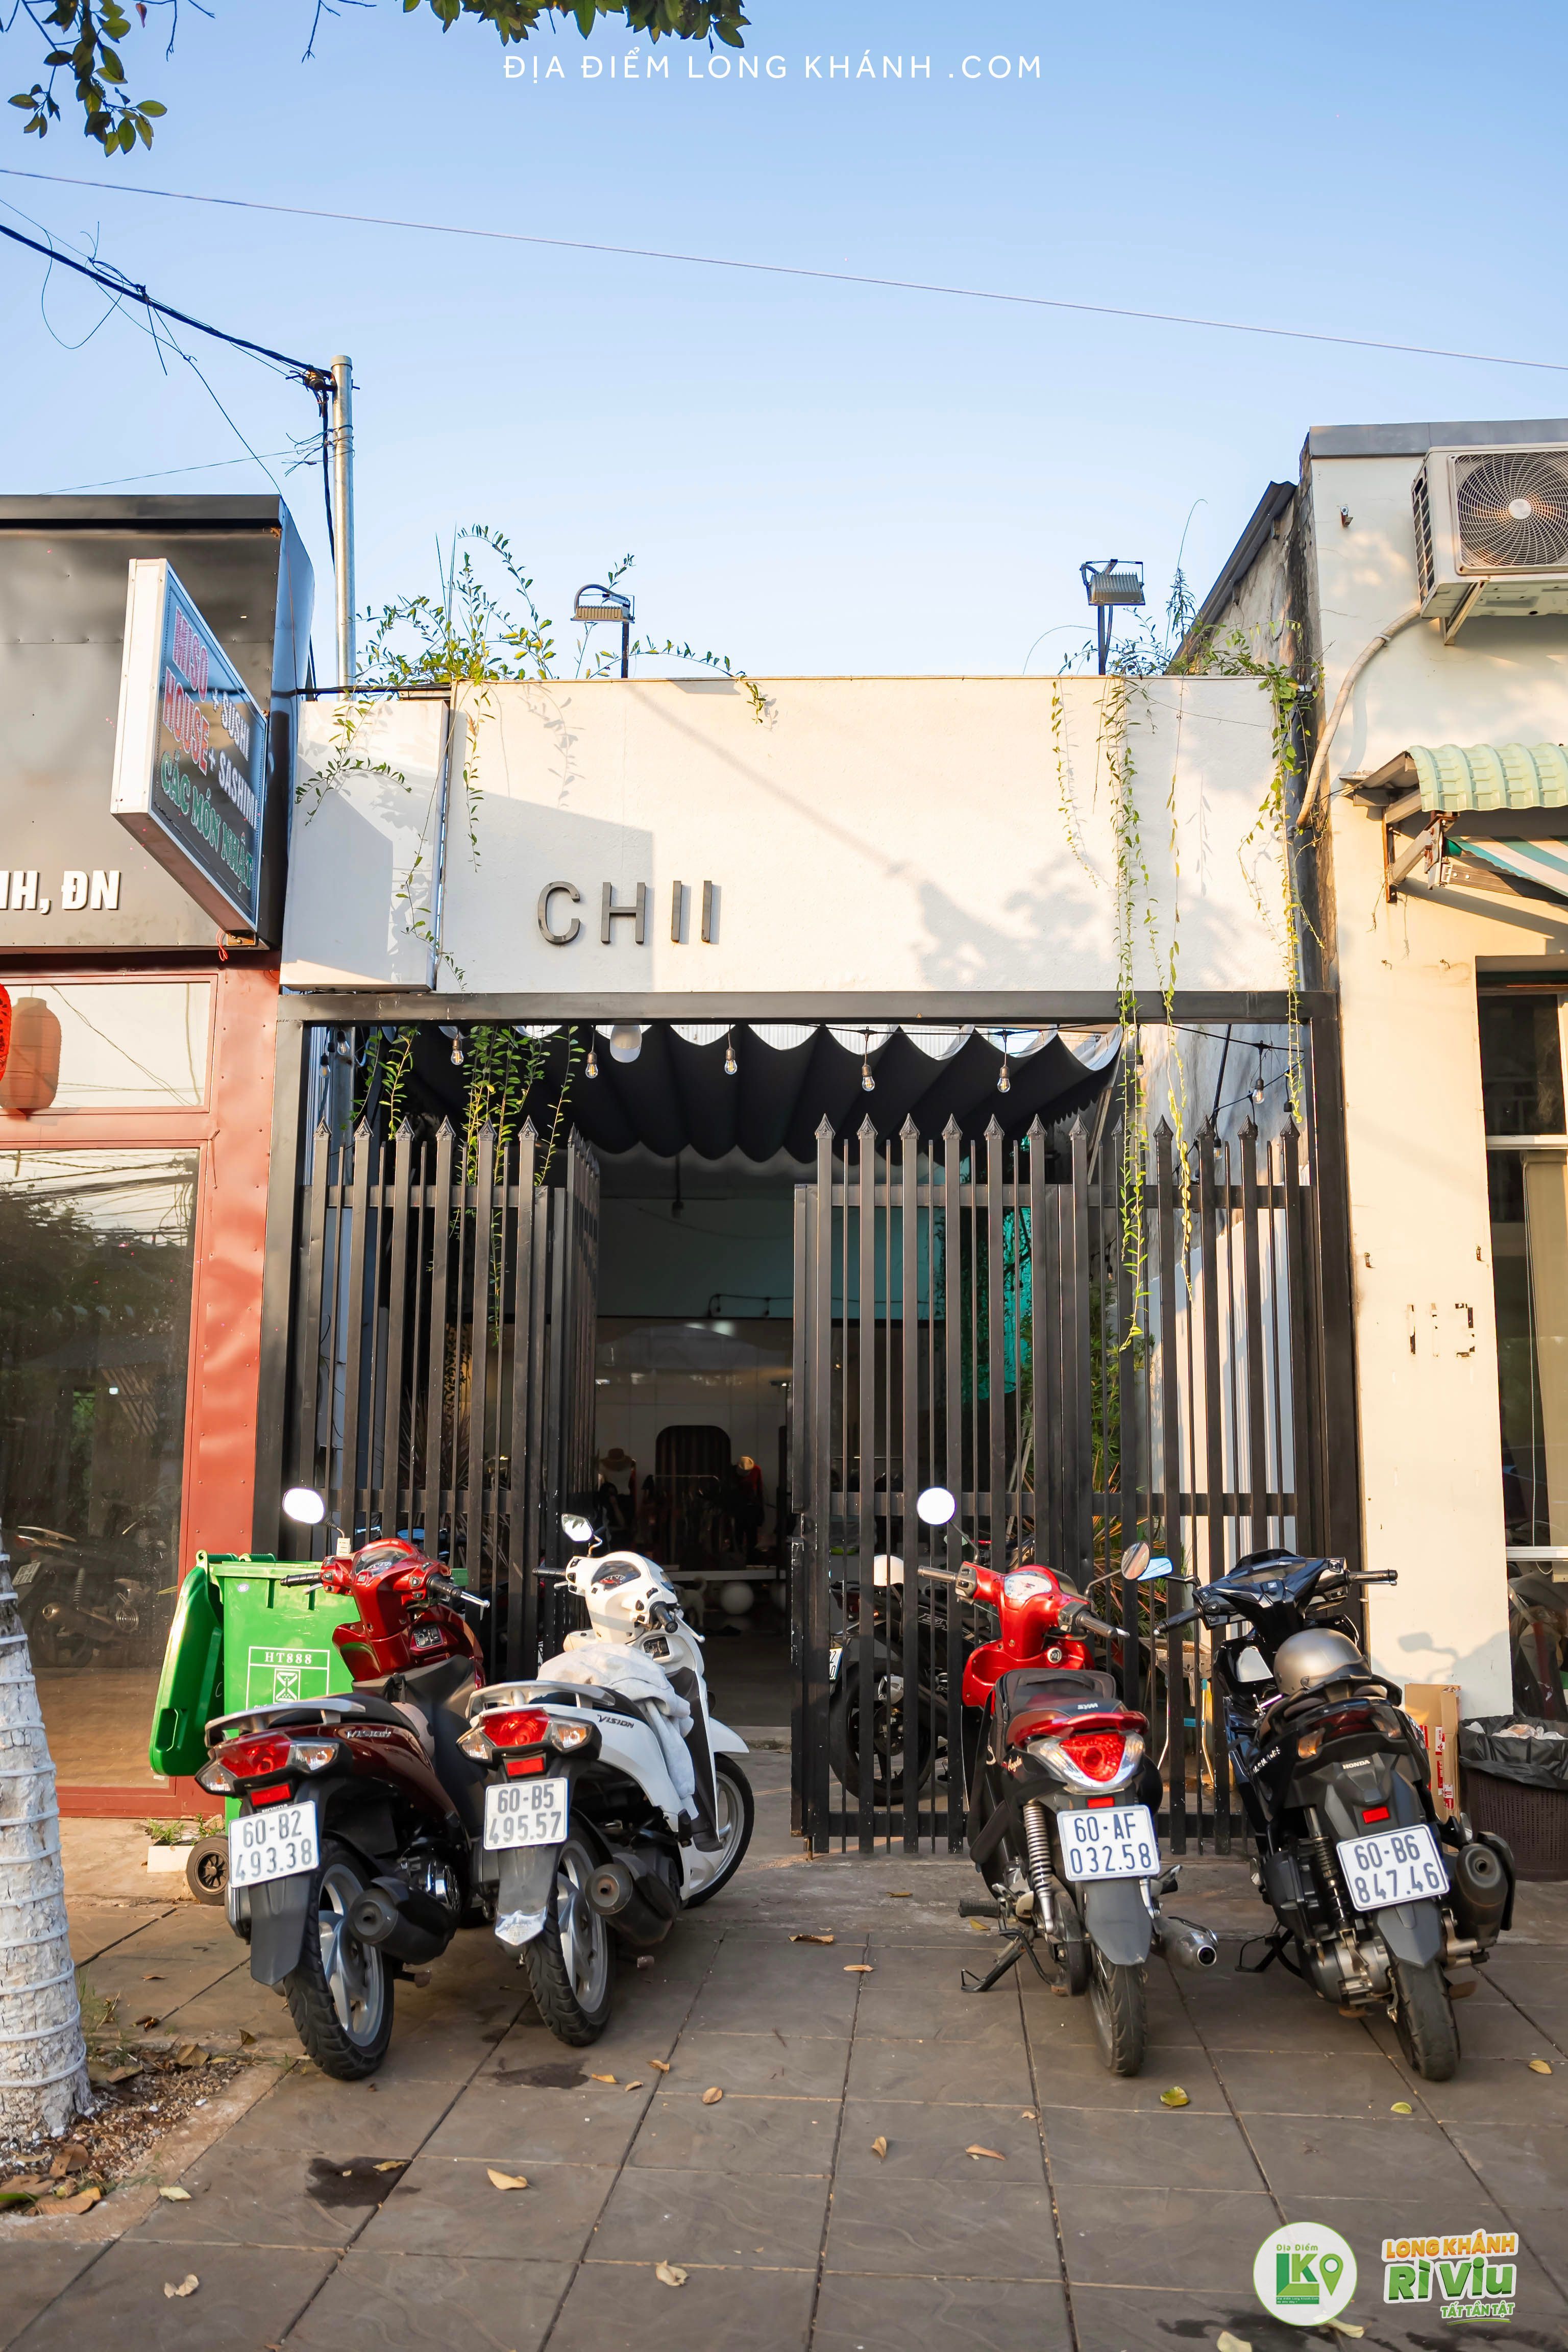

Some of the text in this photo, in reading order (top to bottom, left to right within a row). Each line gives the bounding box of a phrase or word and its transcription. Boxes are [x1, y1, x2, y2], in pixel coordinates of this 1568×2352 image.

[172, 605, 208, 702] MISO
[163, 666, 210, 776] HOUSE
[221, 691, 250, 762] SUSHI
[161, 750, 190, 816] CÁC
[191, 786, 221, 853] MÓN
[61, 870, 120, 910] ĐN
[537, 880, 713, 945] CHII
[264, 1652, 312, 1664] HT888
[597, 1714, 634, 1728] VISION
[1342, 1759, 1370, 1770] HONDA
[498, 1783, 554, 1814] 60-B5
[243, 1810, 302, 1848] 60-B2
[488, 1811, 561, 1845] 495.57
[235, 1838, 312, 1881] 493.38
[1070, 1843, 1152, 1874] 032.58
[1354, 1834, 1420, 1871] 60-B6
[1354, 1863, 1440, 1903] 847.46
